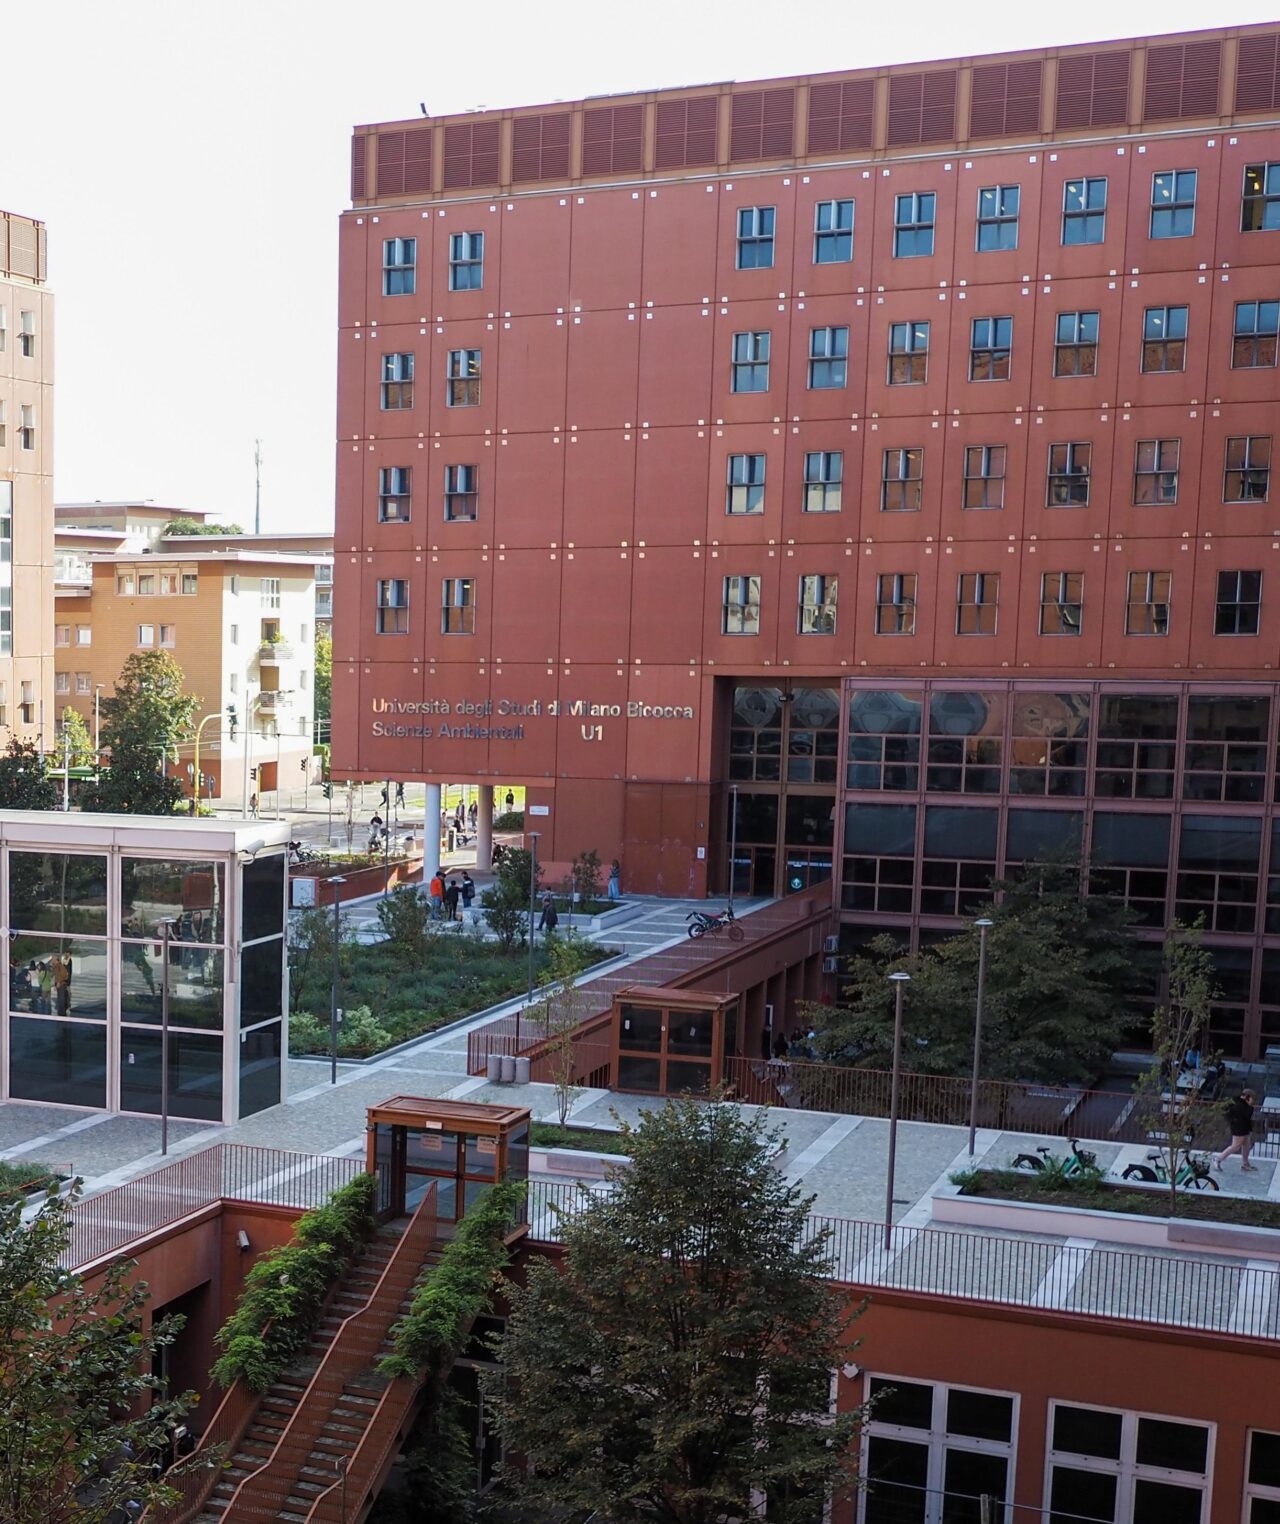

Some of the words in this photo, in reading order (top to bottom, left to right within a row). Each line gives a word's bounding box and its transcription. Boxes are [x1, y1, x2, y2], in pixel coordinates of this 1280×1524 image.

[372, 698, 450, 714] Università
[455, 699, 492, 719] degli
[497, 699, 541, 716] Studi
[548, 700, 561, 716] di
[568, 700, 621, 717] Milano
[627, 701, 694, 719] Bicocca
[372, 721, 433, 738] Scienze
[438, 723, 525, 740] Ambientali
[581, 724, 604, 741] U1
